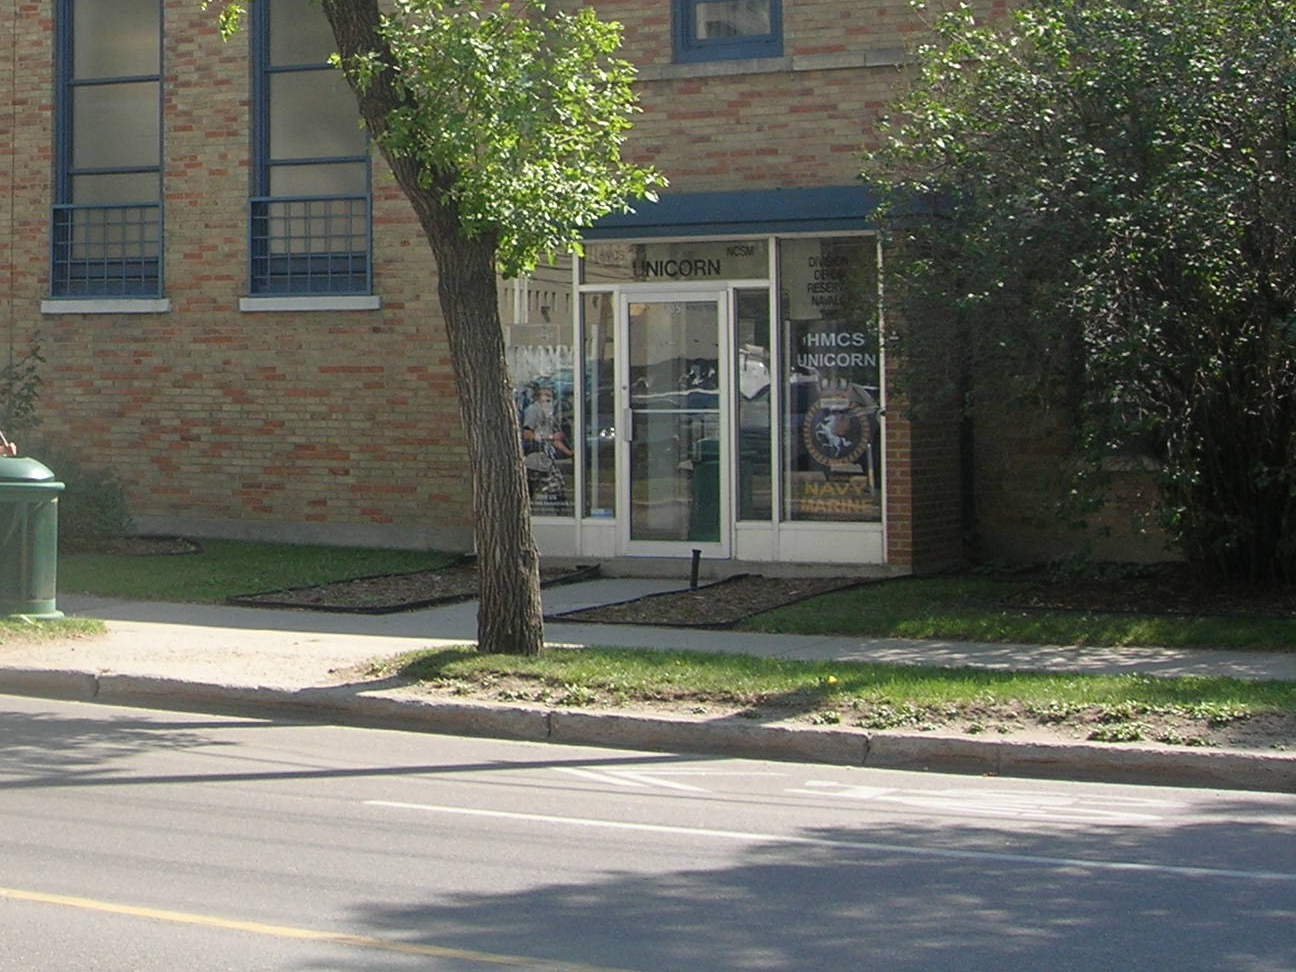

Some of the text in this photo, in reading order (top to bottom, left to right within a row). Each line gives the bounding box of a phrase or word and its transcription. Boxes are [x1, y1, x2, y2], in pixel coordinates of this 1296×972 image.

[726, 245, 754, 257] NCSM
[632, 259, 721, 277] UNICORN
[807, 332, 865, 347] HMCS
[797, 353, 876, 367] UNICORN
[805, 481, 865, 495] NAVY
